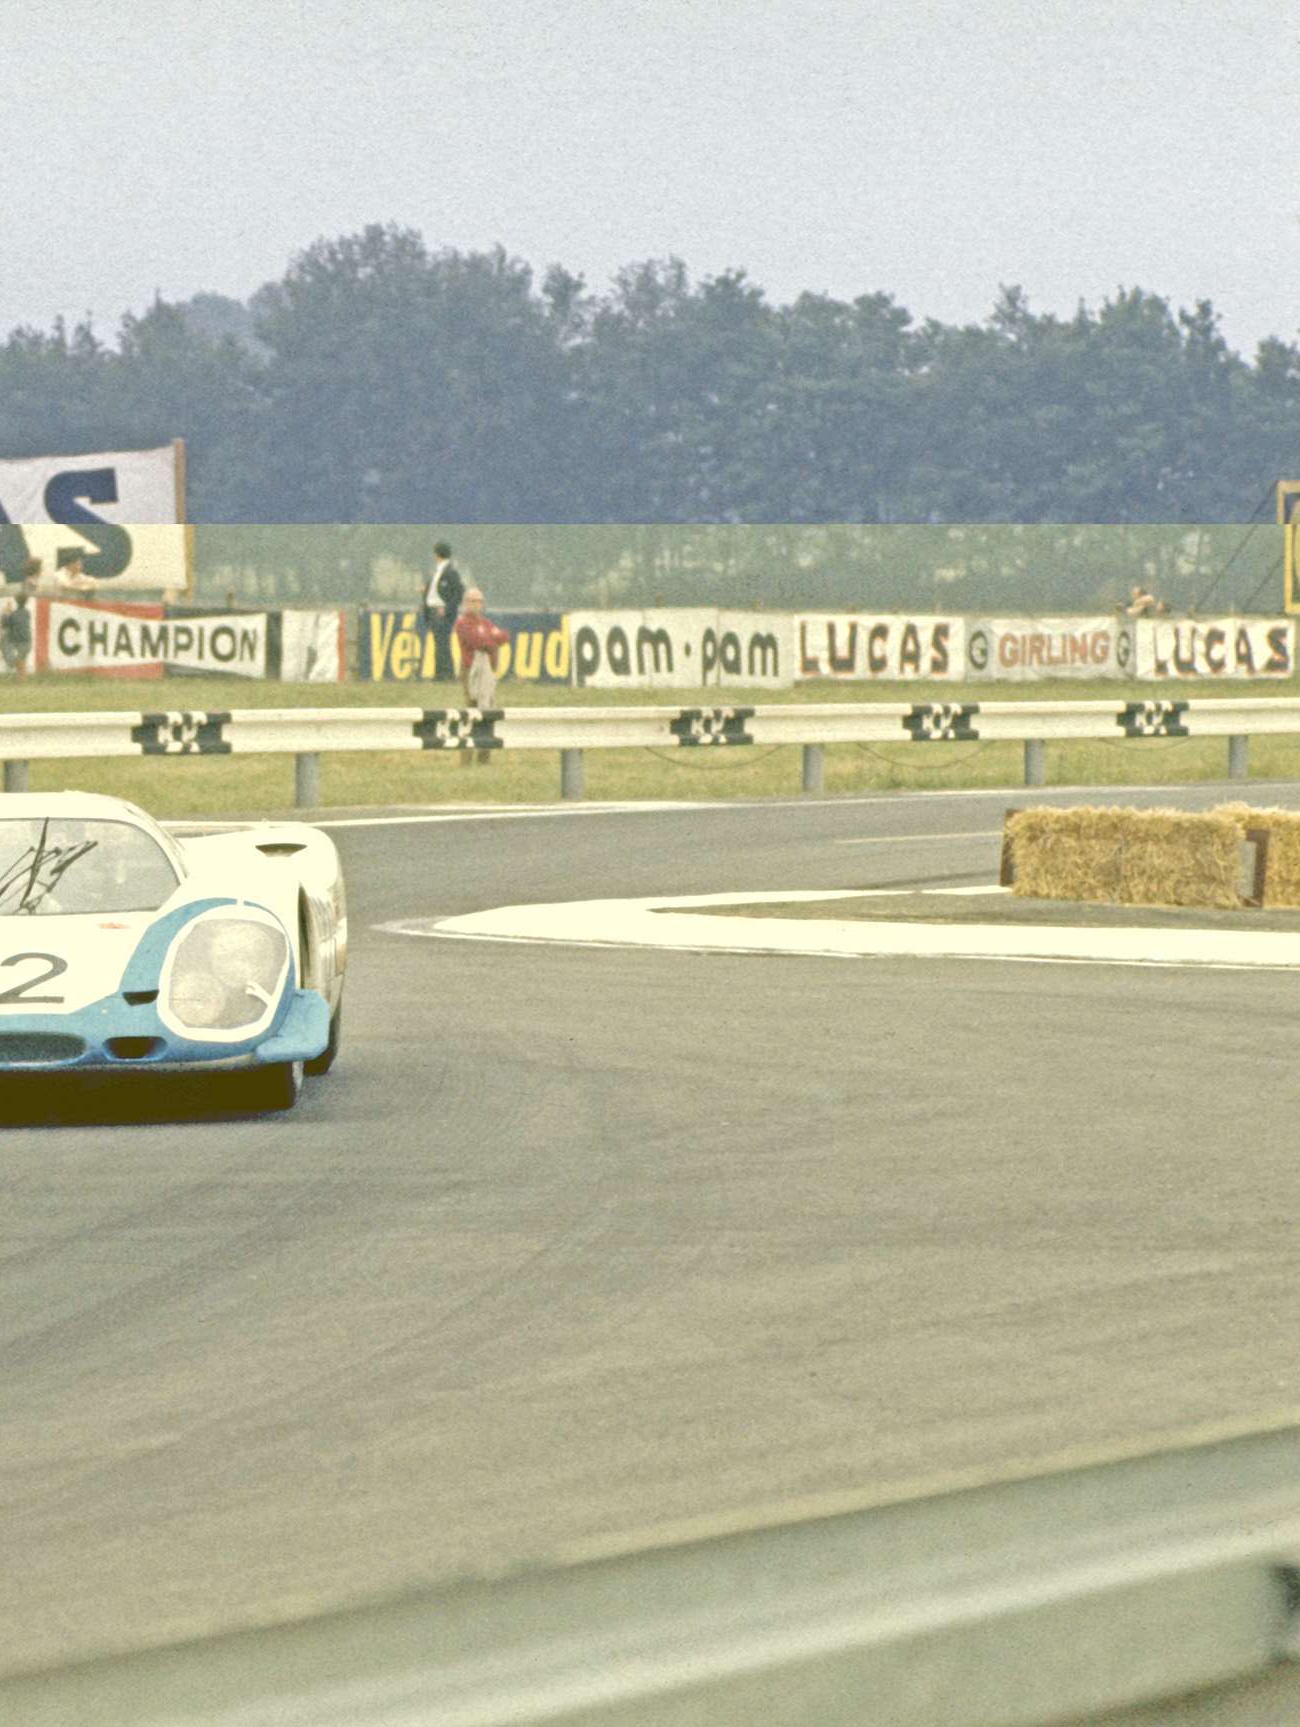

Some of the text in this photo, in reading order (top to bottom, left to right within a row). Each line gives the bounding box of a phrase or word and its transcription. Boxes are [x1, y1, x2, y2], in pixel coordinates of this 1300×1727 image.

[58, 618, 257, 663] CHAMPION
[800, 621, 950, 674] LUCAS
[999, 631, 1111, 668] GIRLING
[1154, 626, 1290, 676] LUCAS
